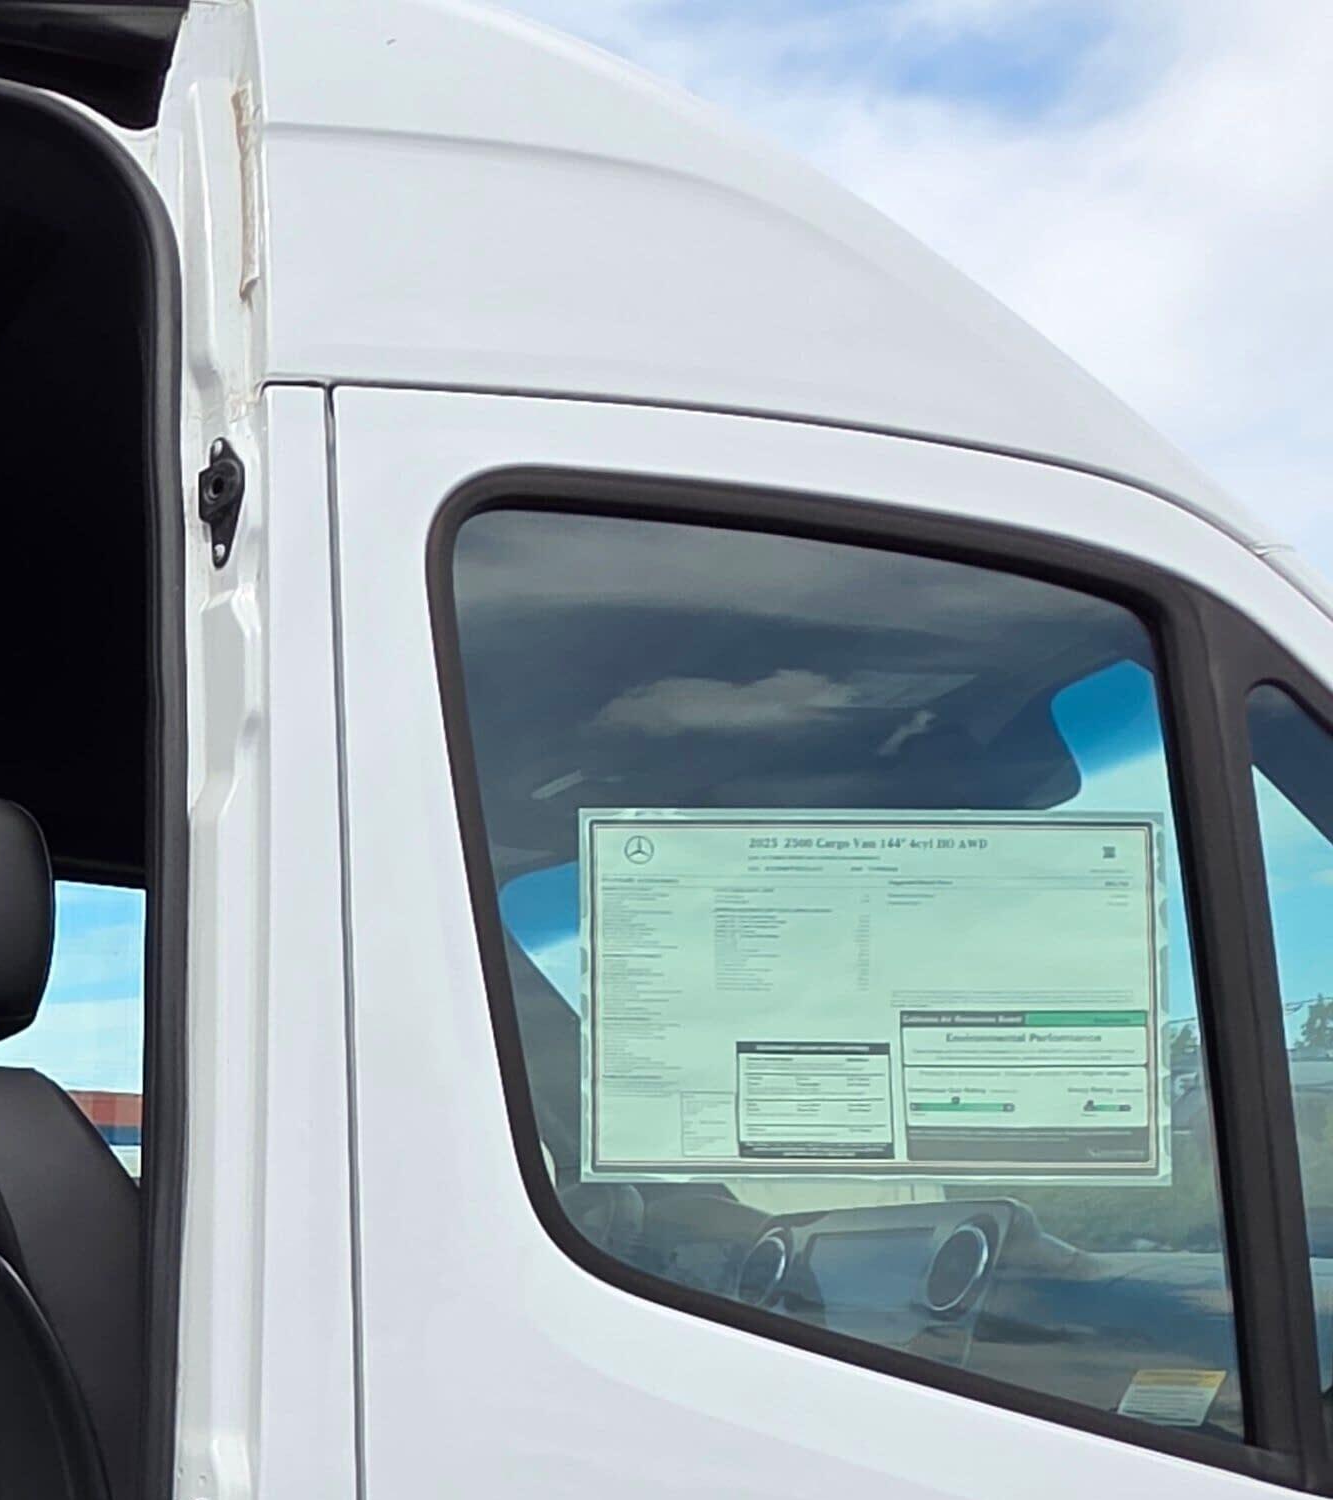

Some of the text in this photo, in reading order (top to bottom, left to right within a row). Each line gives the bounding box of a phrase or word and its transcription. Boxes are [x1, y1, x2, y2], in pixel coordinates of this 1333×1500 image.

[749, 837, 778, 849] 2025
[784, 837, 813, 849] 2500
[816, 837, 850, 851] Cargo
[852, 837, 877, 849] Van
[958, 838, 988, 849] AWD
[946, 1032, 1102, 1042] Environmental Performance
